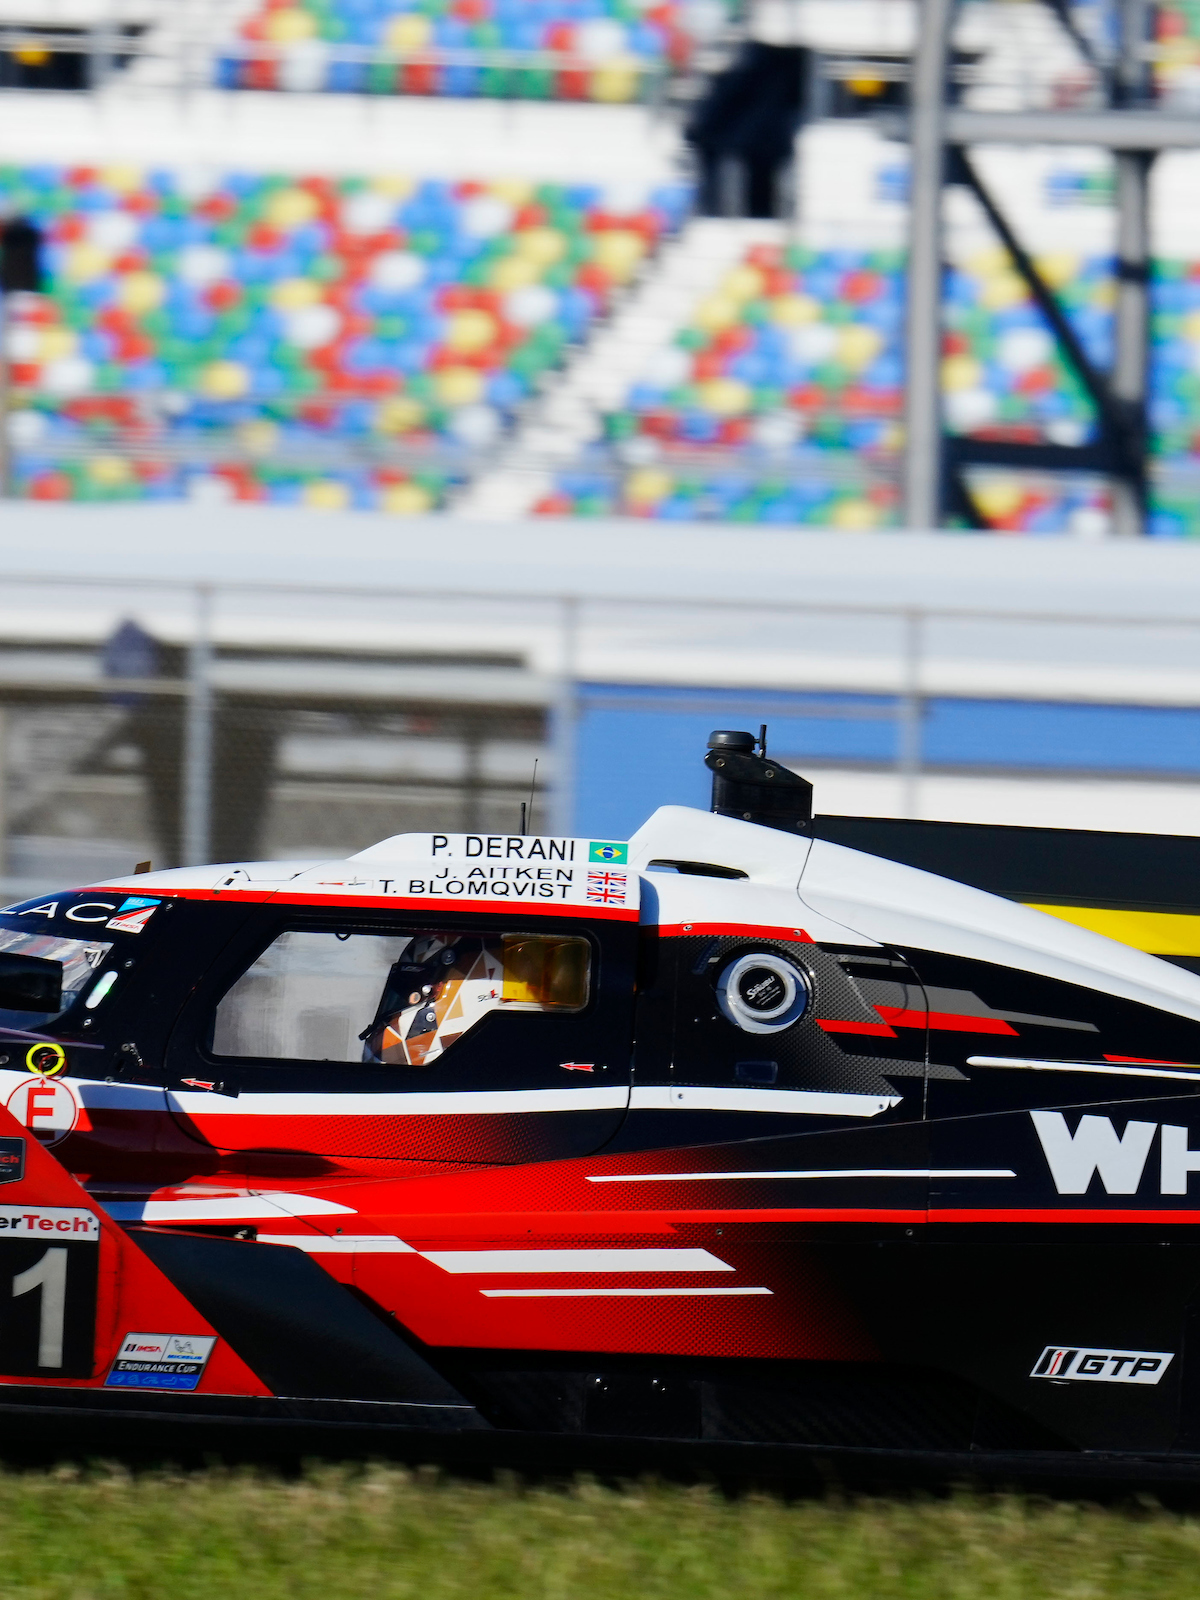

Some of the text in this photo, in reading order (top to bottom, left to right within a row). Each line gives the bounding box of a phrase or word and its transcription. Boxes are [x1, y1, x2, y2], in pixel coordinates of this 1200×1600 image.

[432, 835, 575, 862] P. DERANI
[435, 867, 574, 881] J. AITKEN
[379, 879, 573, 899] T. BLOMQVIST
[26, 1087, 56, 1141] E
[136, 1345, 162, 1353] IMSA
[1076, 1354, 1162, 1377] GTP
